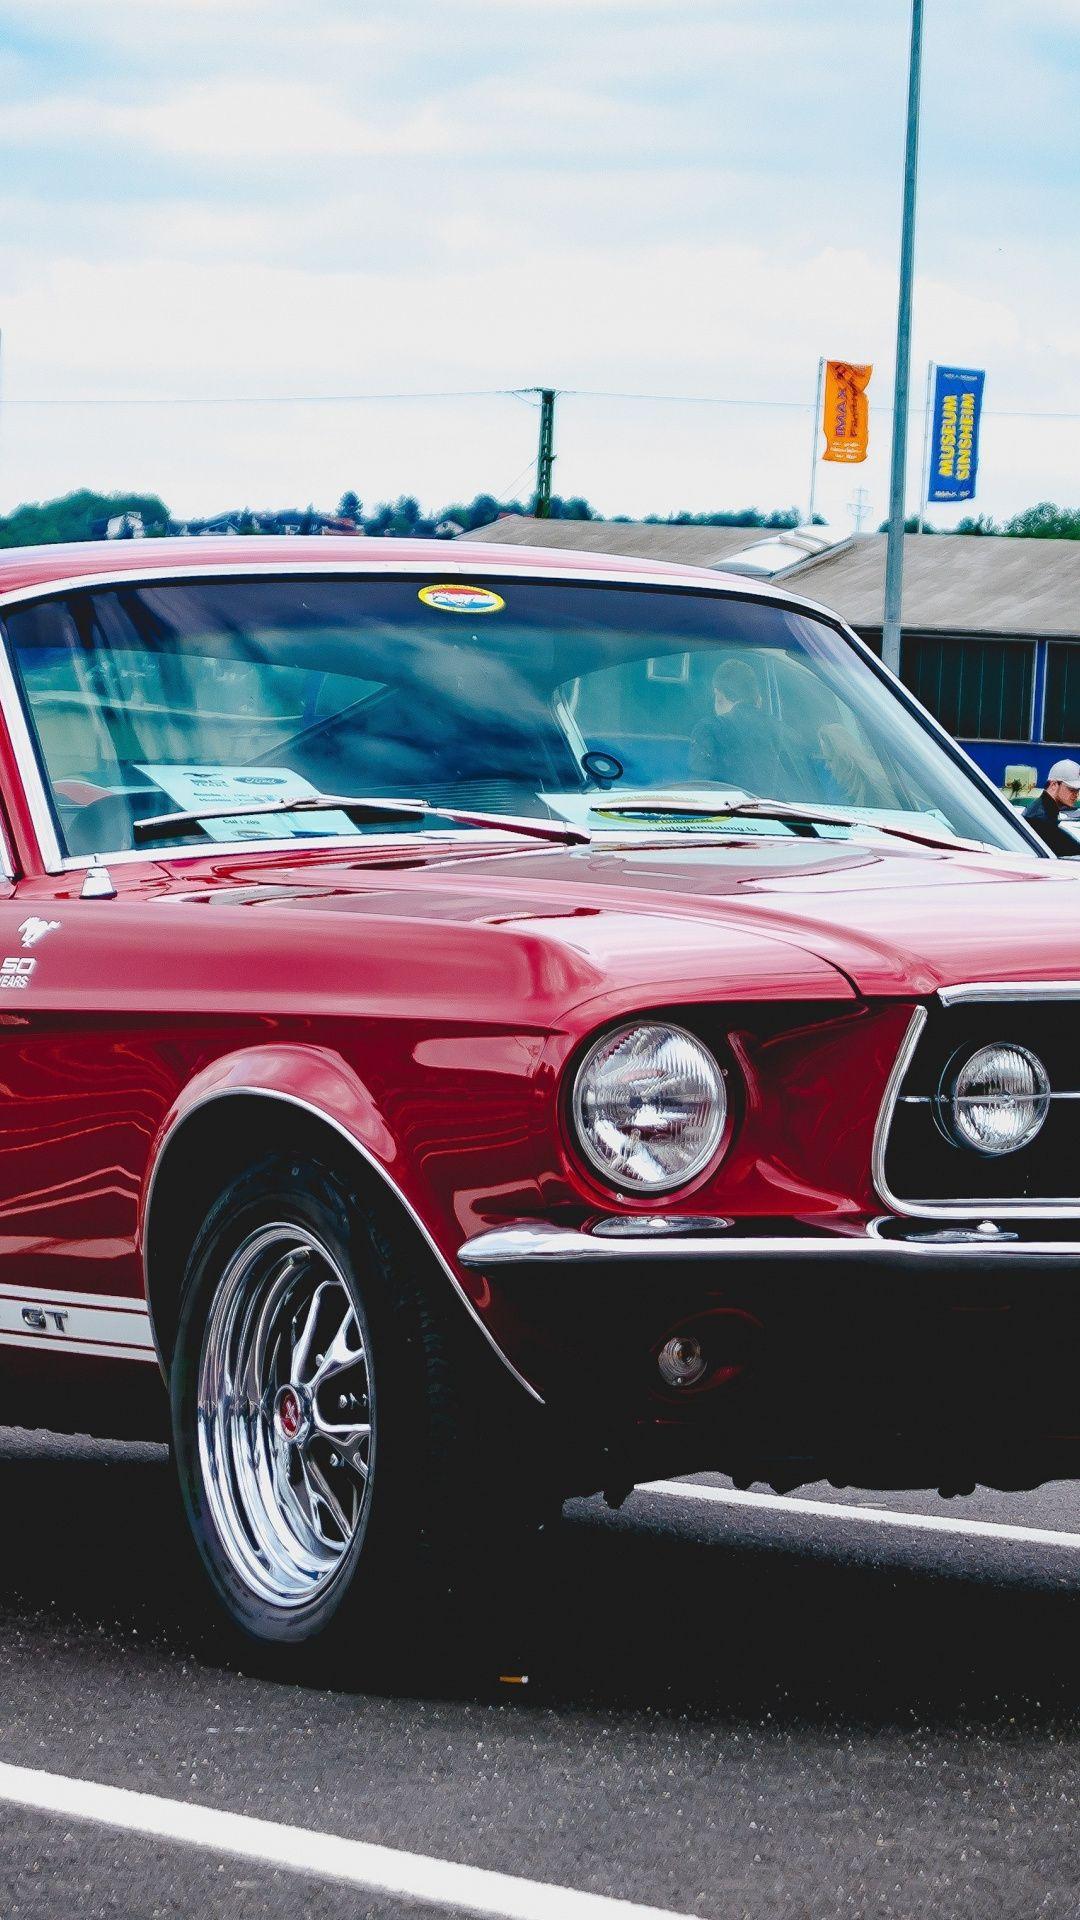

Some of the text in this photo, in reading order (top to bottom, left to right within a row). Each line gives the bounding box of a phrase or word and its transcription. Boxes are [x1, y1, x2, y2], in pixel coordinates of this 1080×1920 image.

[835, 388, 847, 437] IMAX
[938, 395, 957, 477] MUSEUM
[956, 393, 975, 480] SINSHEIM
[0, 957, 37, 975] 50
[21, 1307, 69, 1333] GT
